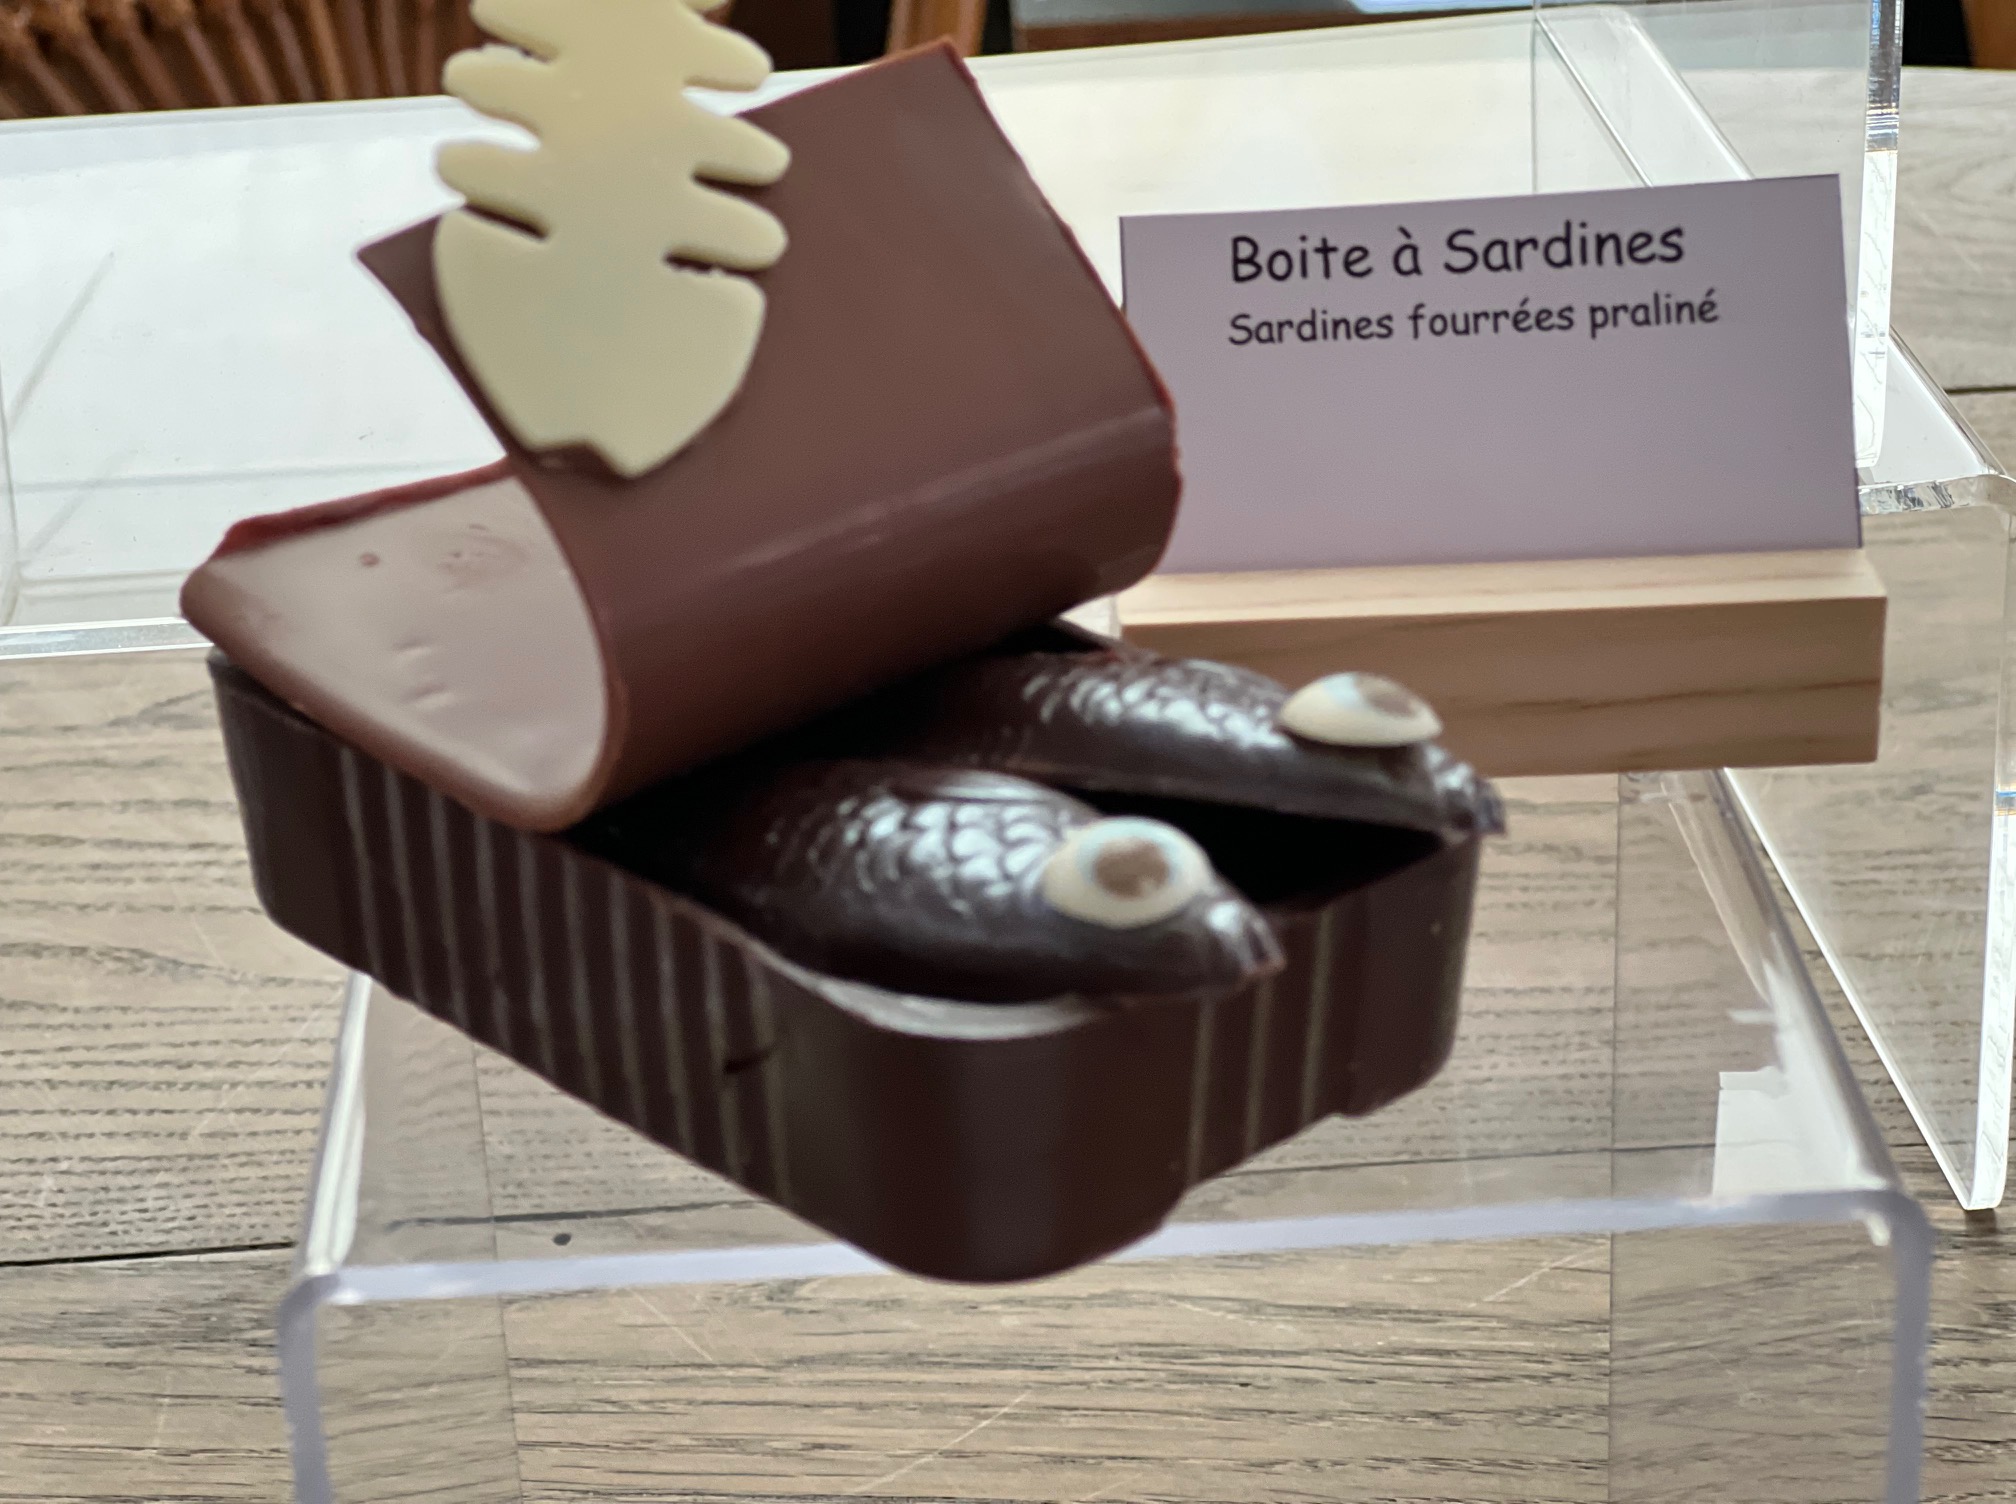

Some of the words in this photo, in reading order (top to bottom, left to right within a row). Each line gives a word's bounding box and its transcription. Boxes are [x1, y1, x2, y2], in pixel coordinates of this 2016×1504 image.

[1230, 234, 1374, 284] Boite
[1392, 225, 1424, 278] à
[1443, 218, 1686, 275] Sardines
[1228, 307, 1394, 346] Sardines
[1407, 296, 1575, 340] fourrées
[1588, 287, 1720, 340] praliné
